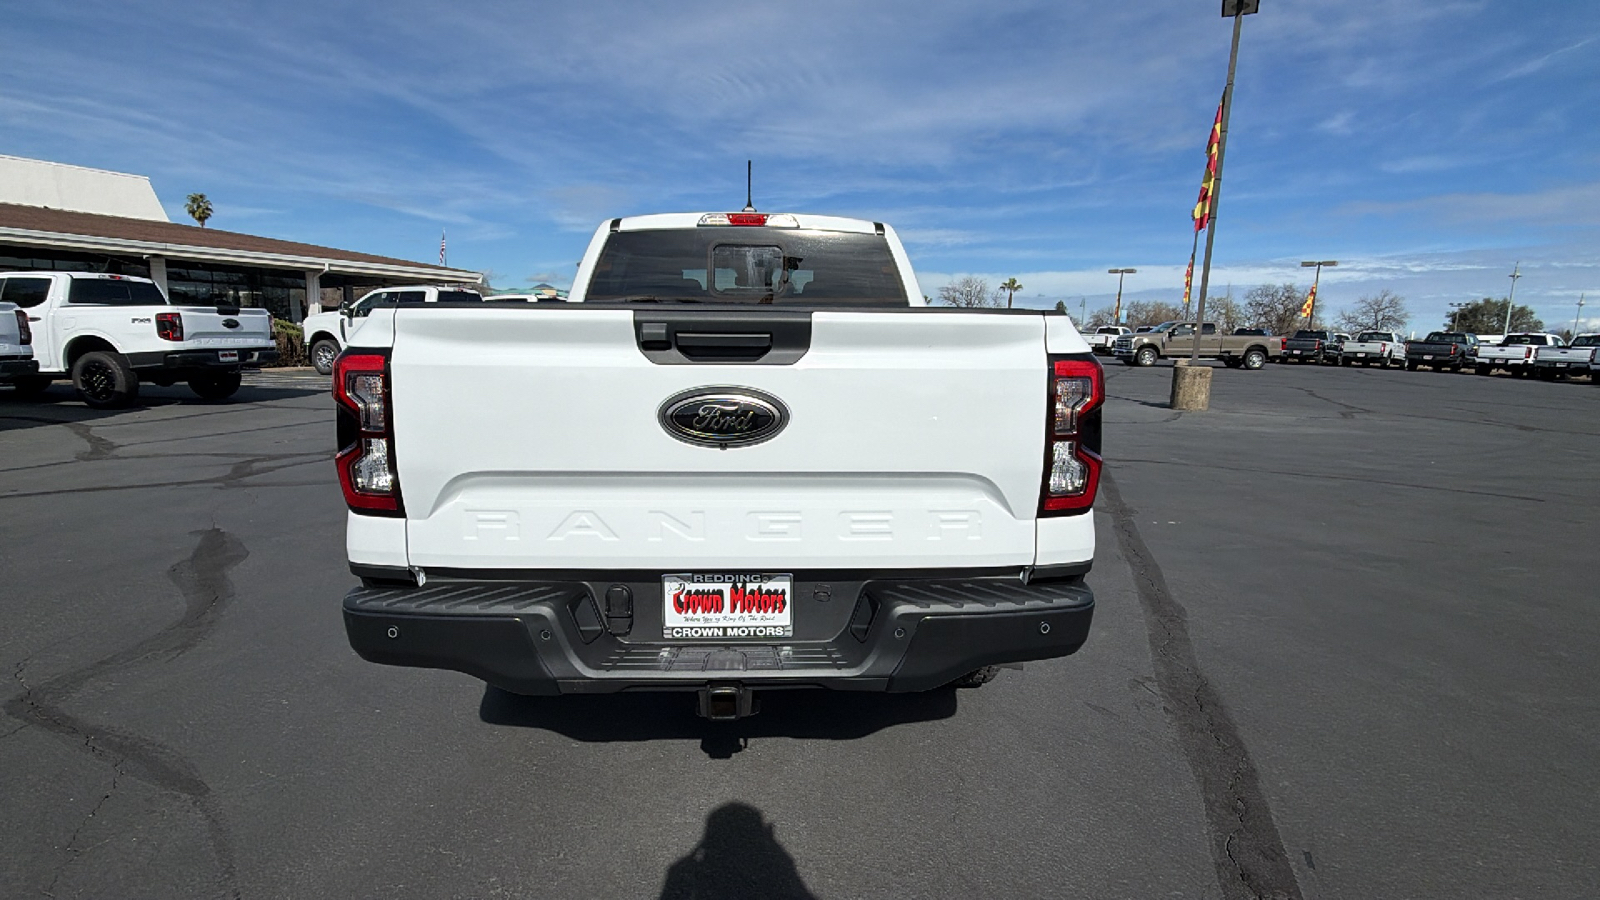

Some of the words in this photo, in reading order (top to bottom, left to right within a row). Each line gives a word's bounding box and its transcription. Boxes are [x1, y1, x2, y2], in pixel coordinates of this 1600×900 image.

[692, 404, 753, 430] Ford
[462, 508, 983, 541] RANGER
[693, 574, 761, 583] REDDING
[672, 586, 724, 615] Crown
[730, 585, 787, 614] Motors
[672, 627, 723, 637] CROWN
[727, 627, 784, 636] MOTORS
